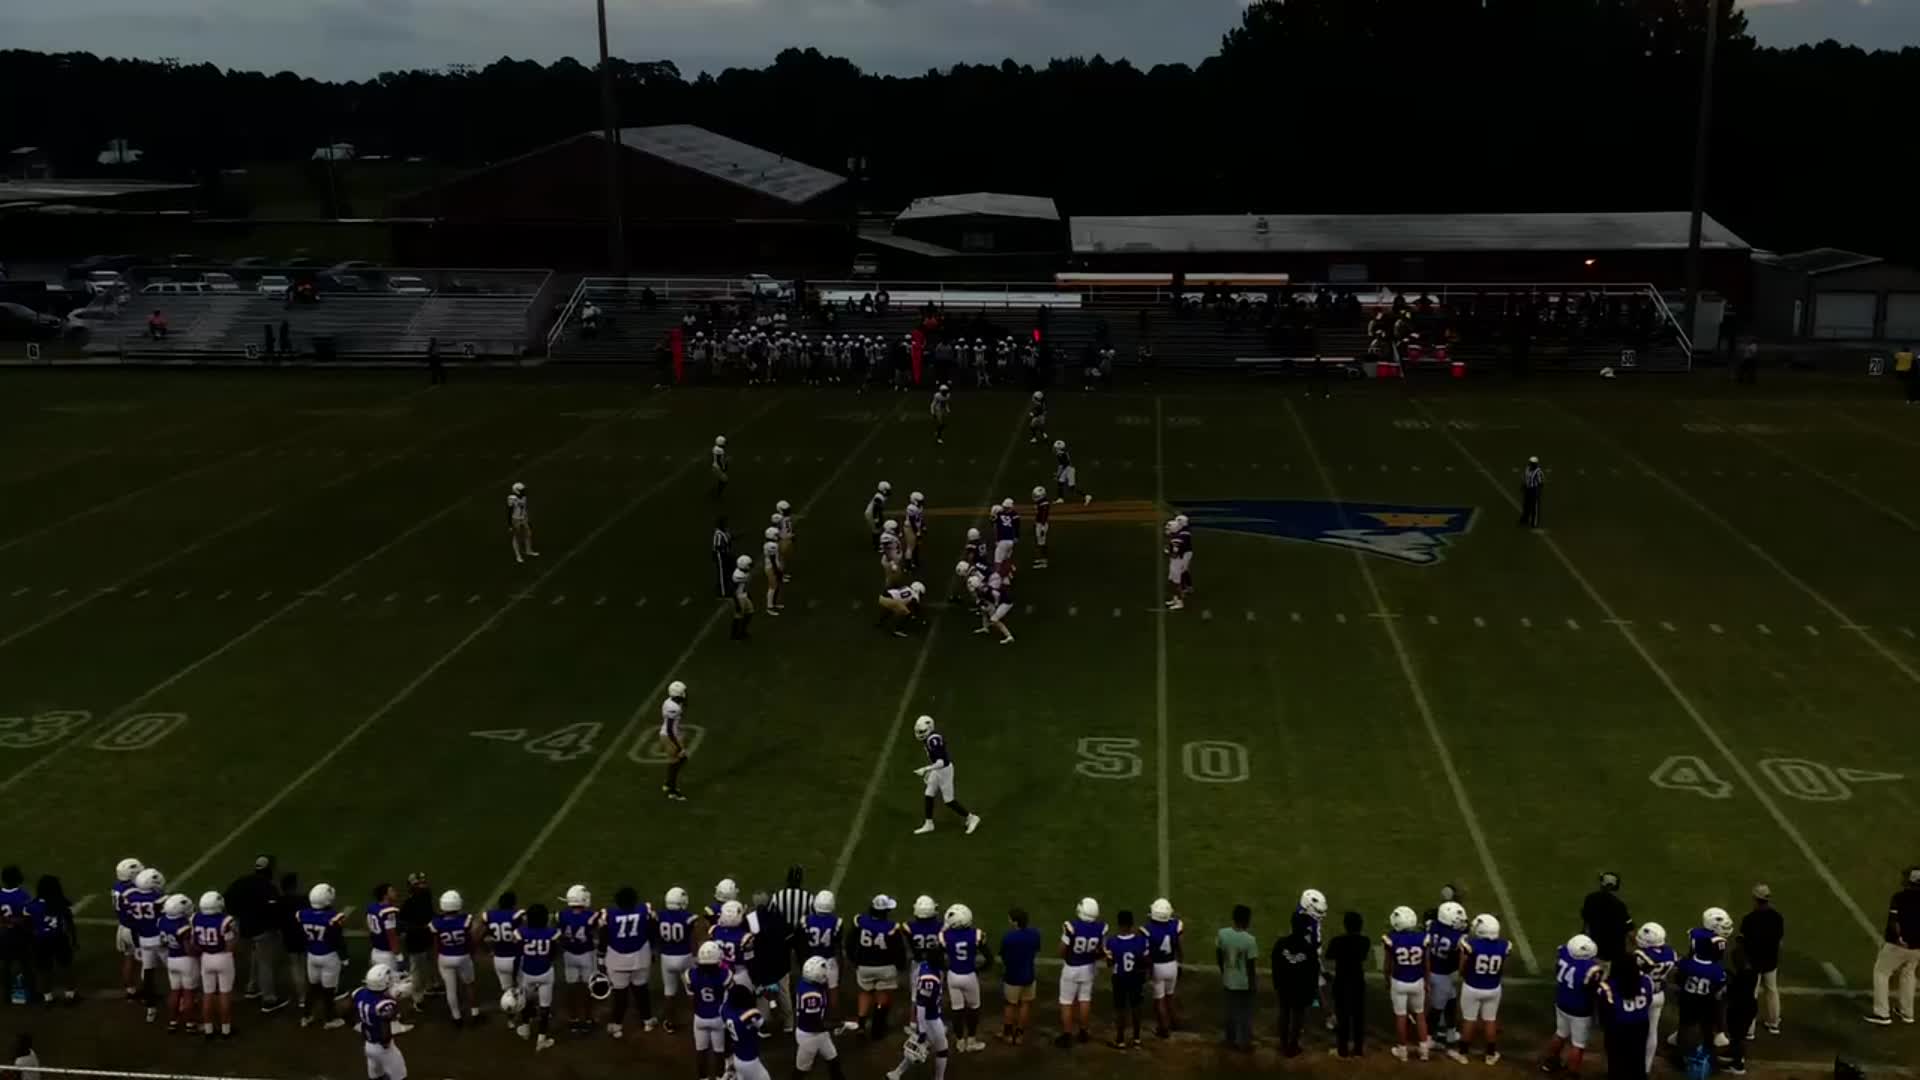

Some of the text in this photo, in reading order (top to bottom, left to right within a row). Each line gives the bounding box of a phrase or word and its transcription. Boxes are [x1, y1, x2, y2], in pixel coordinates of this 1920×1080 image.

[127, 901, 155, 920] 33
[303, 923, 327, 942] 57
[488, 921, 513, 943] 36
[616, 913, 640, 939] 77
[439, 929, 466, 947] 25
[806, 925, 832, 948] 34
[860, 929, 888, 950] 64
[1160, 934, 1173, 954] 4
[523, 938, 551, 956] 20
[955, 941, 969, 961] 5
[1395, 946, 1424, 966] 22
[1122, 951, 1136, 972] 6
[1475, 953, 1502, 975] 60
[1557, 958, 1577, 990] 74
[701, 986, 715, 1003] 6
